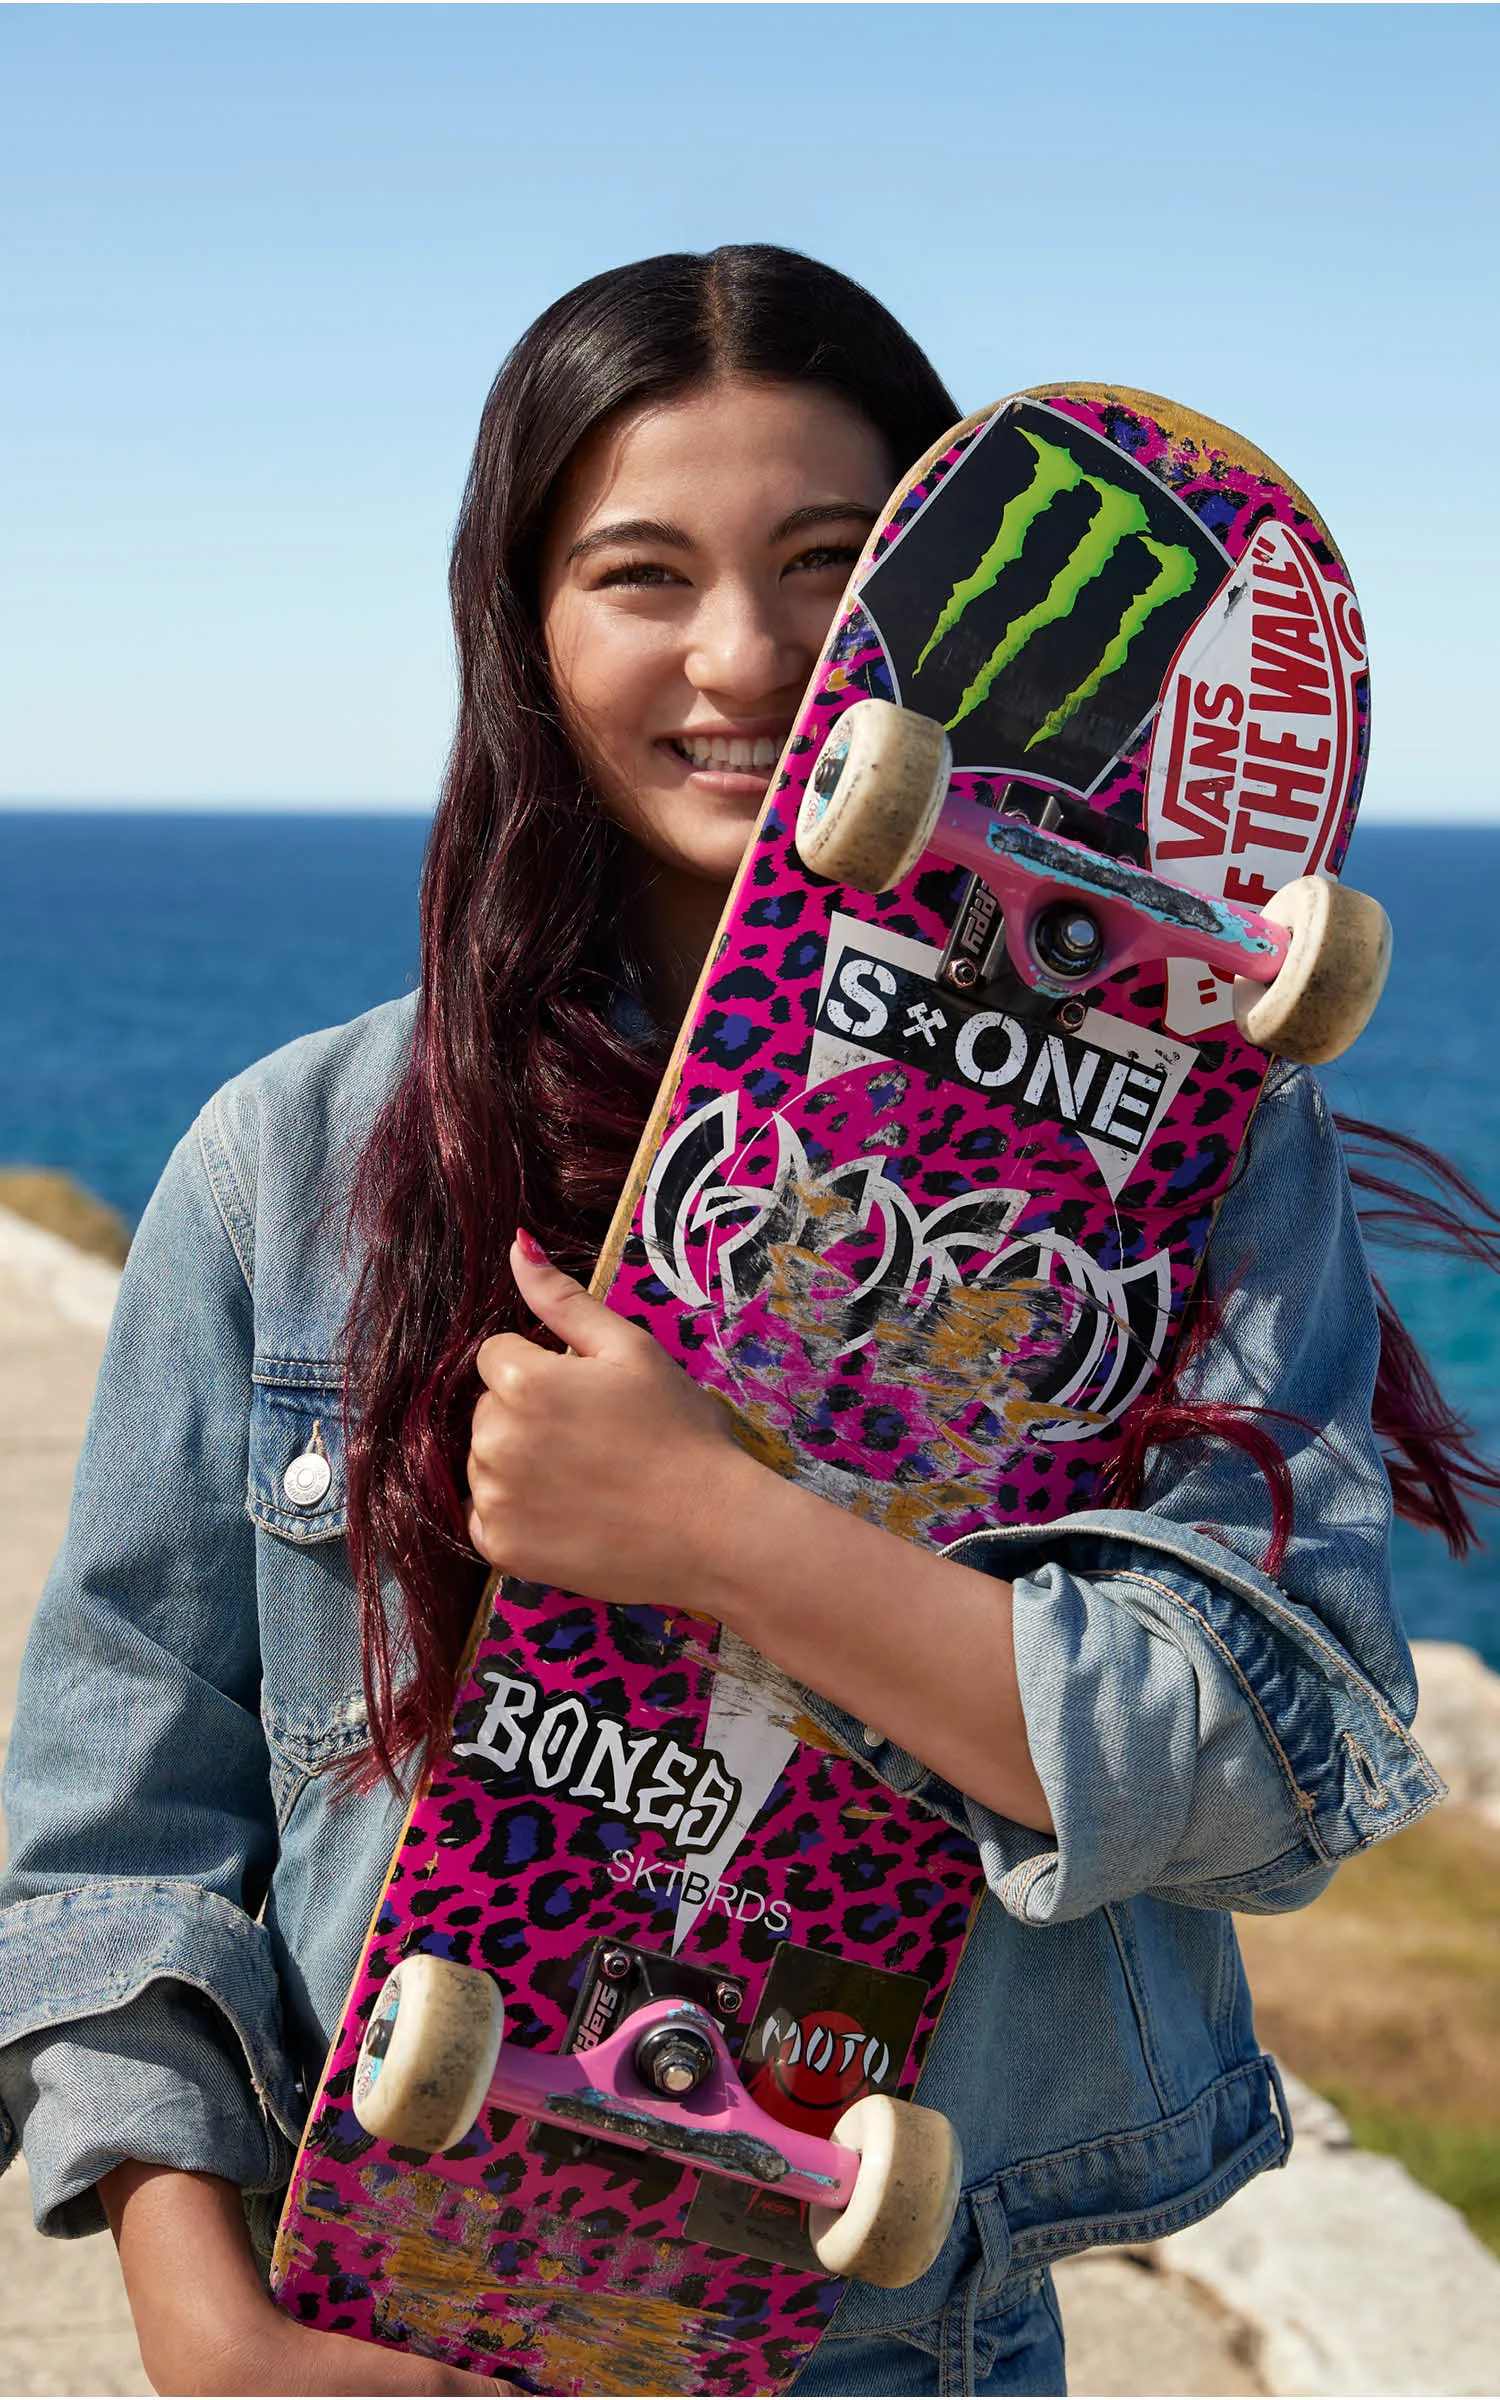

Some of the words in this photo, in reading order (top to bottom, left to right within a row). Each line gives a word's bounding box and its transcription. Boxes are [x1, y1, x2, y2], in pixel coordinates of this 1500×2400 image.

[1248, 533, 1333, 717] WALL"
[1155, 673, 1244, 861] VANS
[1230, 715, 1333, 868] THE
[451, 1671, 735, 1848] BONES
[605, 1847, 793, 1933] SKTBRDS
[761, 2015, 890, 2085] MOTO
